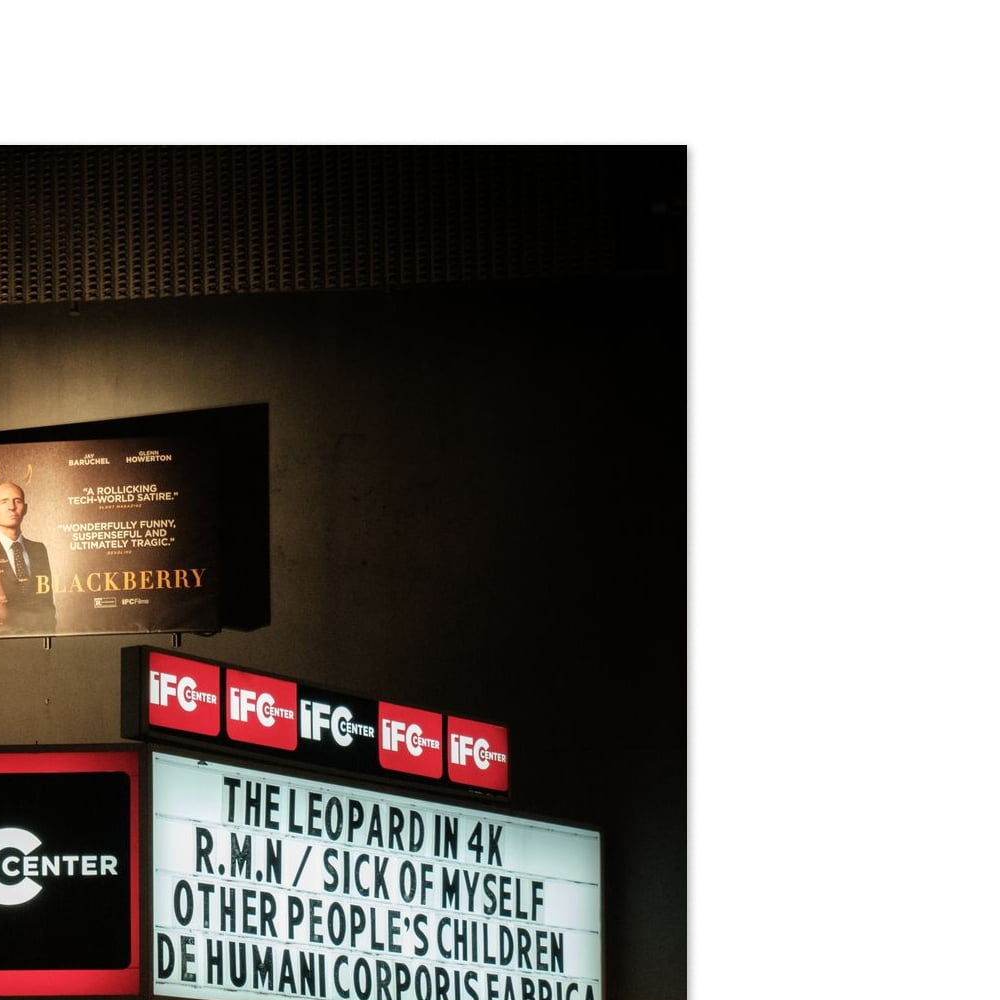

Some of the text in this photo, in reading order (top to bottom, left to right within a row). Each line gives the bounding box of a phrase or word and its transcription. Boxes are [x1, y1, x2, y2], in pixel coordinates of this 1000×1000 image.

[68, 457, 110, 466] BARUCHEL
[126, 454, 172, 464] HOWERTON
[96, 484, 157, 496] ROLLICKING
[67, 494, 135, 505] TECH-WORLD
[139, 519, 177, 529] FUNNY,
[72, 528, 167, 541] SUSPENSEFUL AND
[70, 539, 128, 551] ULTIMATELY
[35, 568, 207, 595] BLACKBERRY
[185, 688, 217, 704] CENTER
[263, 705, 295, 720] CENTER
[340, 720, 375, 738] CENTER
[411, 733, 440, 749] CENTER
[479, 749, 507, 763] CENTER
[223, 776, 503, 867] THE LEOPARD IN 4K
[2, 855, 118, 877] CENTER
[195, 827, 282, 885] R.M.N
[323, 848, 389, 900] SICK
[399, 860, 434, 905] OF
[441, 867, 544, 922] MYSELF
[173, 879, 277, 938] OTHER
[437, 917, 565, 974] CHILDREN
[157, 933, 197, 982] DE
[206, 939, 327, 998] HUMANI
